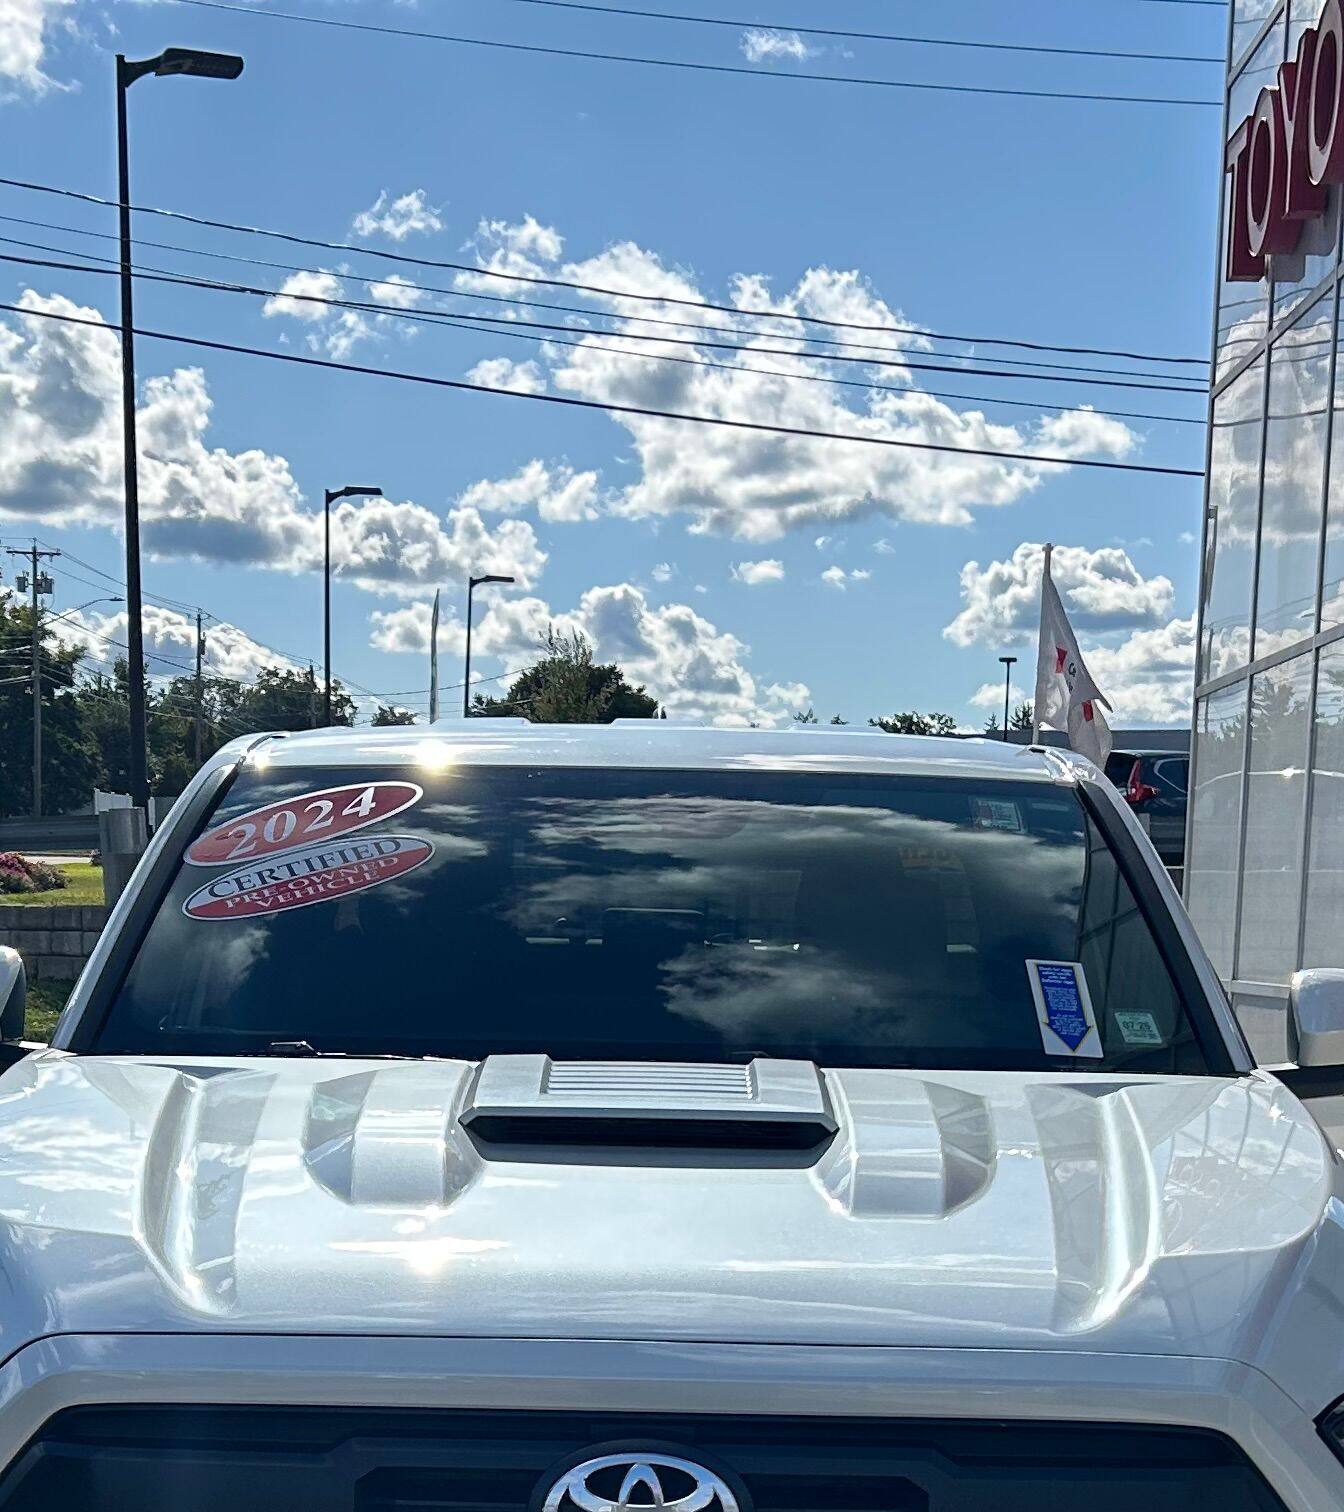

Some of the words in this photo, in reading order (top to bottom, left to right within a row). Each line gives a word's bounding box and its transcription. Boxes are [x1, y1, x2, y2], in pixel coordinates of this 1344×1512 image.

[225, 786, 377, 860] 2024
[207, 839, 402, 899] CERTIFIED
[226, 856, 400, 908] PRE-OWNED
[255, 869, 379, 908] VEHICLE
